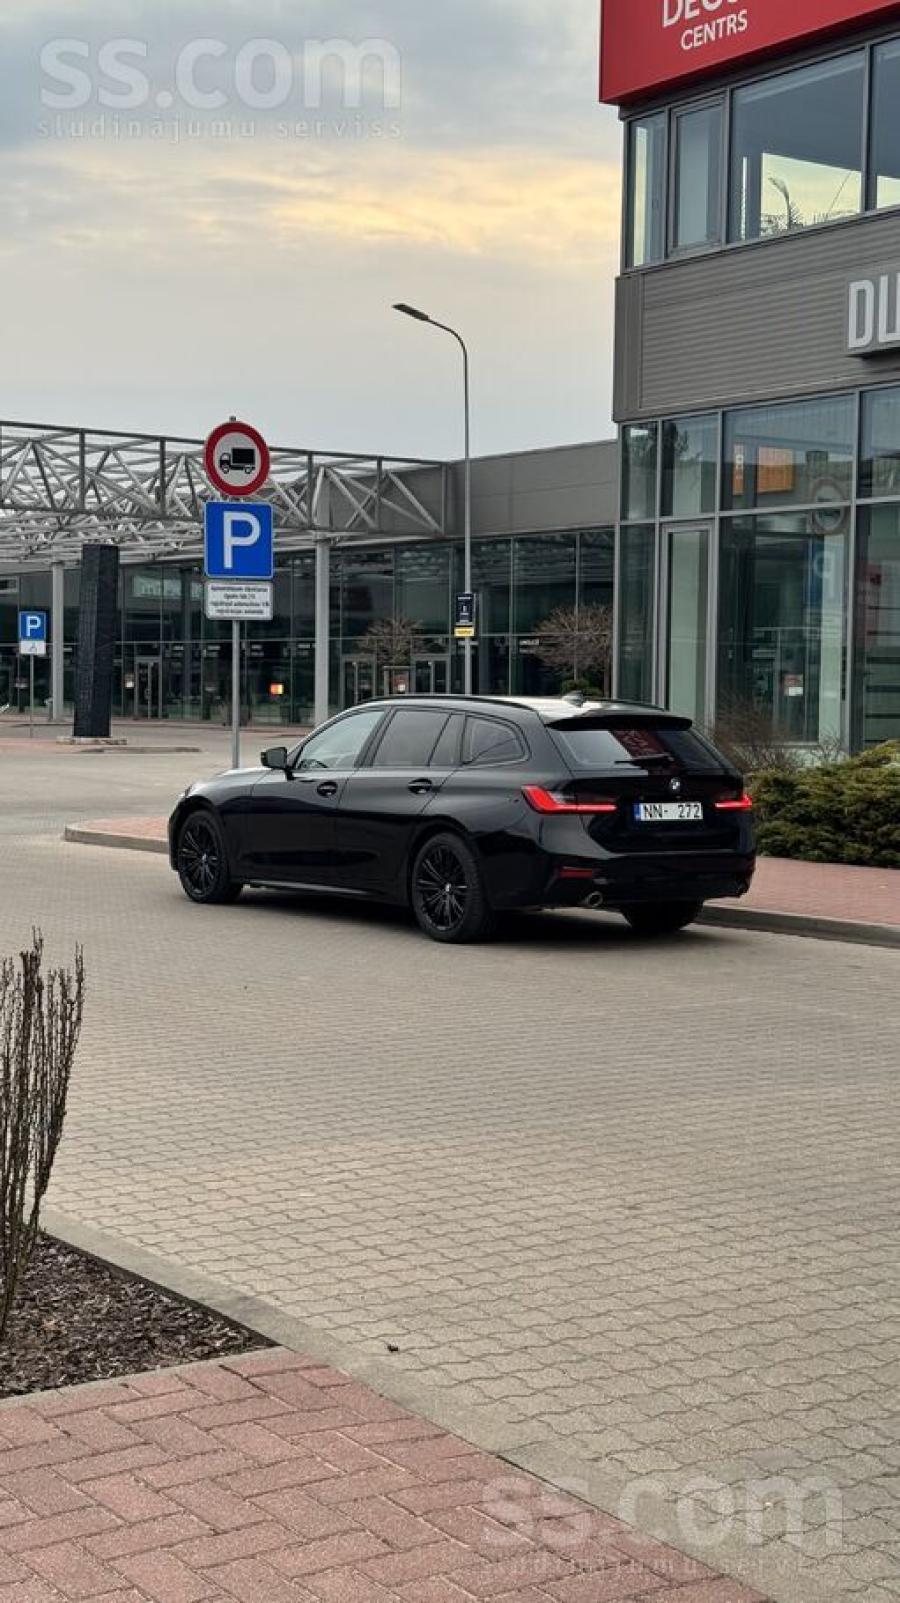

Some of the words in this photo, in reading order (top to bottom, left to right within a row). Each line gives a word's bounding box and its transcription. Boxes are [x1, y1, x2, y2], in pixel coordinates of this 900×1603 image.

[681, 9, 748, 50] CENTRS
[223, 511, 260, 569] P
[26, 616, 41, 636] P
